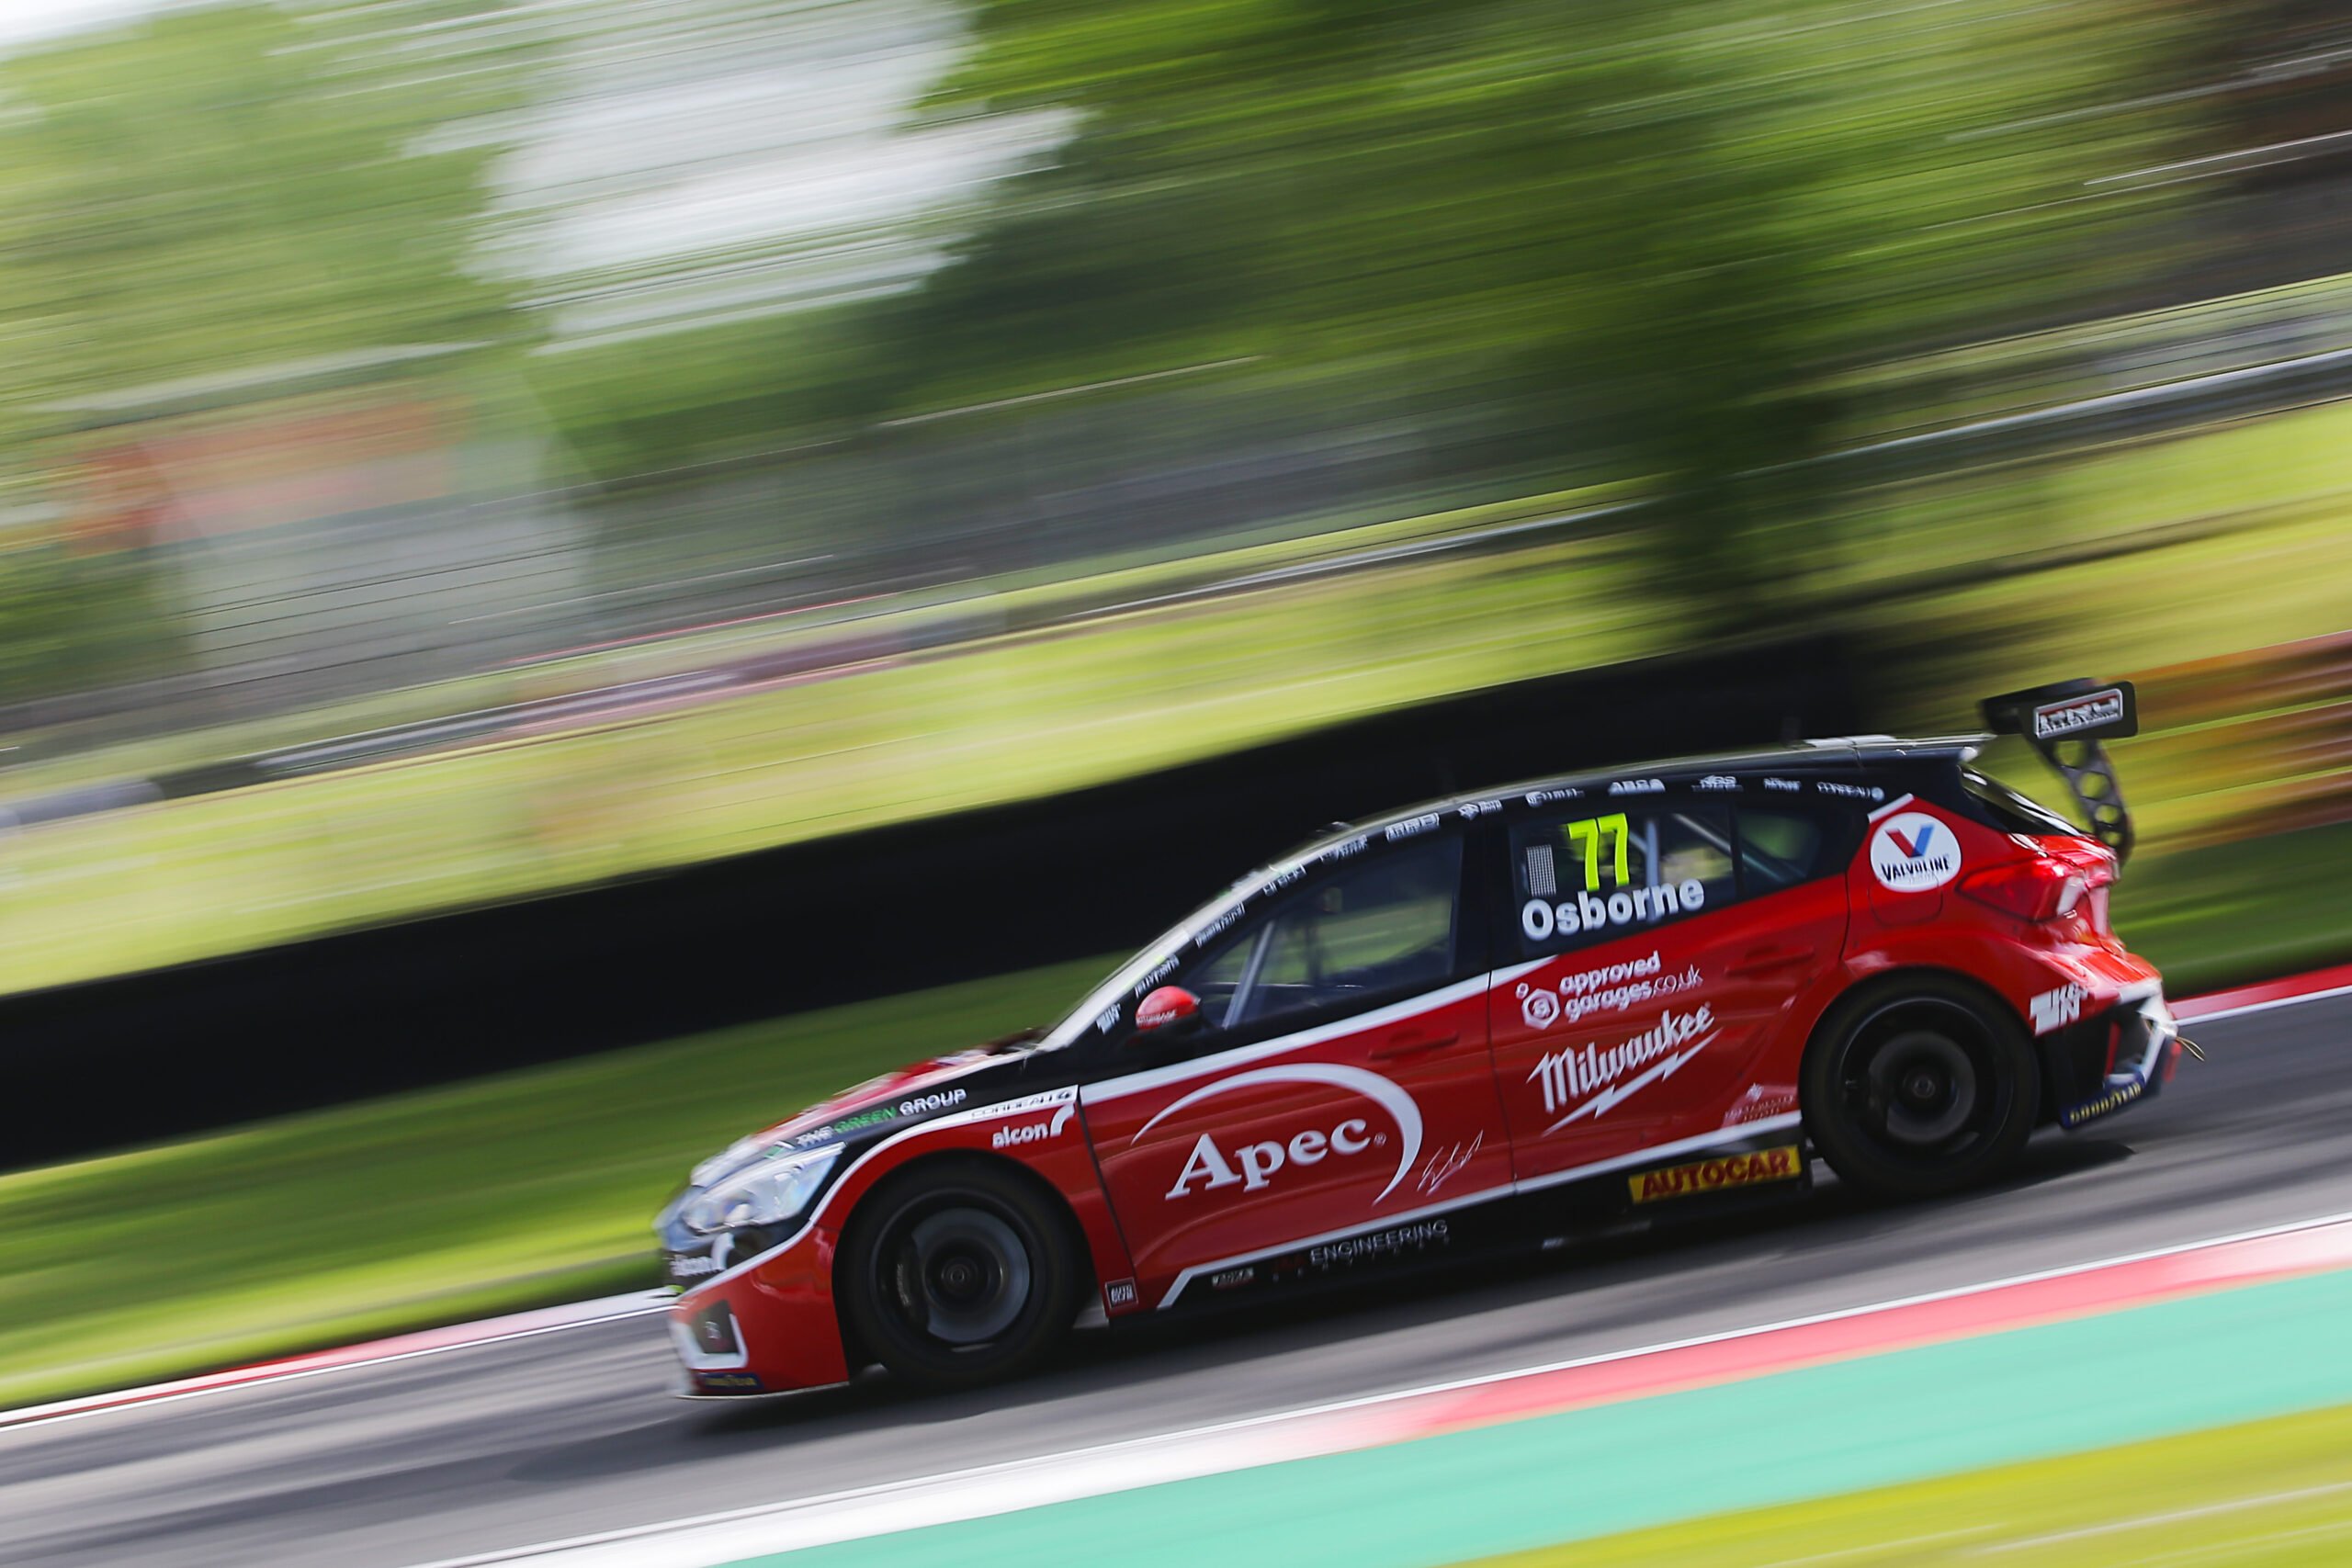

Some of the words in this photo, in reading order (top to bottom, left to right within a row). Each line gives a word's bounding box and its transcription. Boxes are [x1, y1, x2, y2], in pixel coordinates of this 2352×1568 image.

[1567, 813, 1629, 891] 77
[1521, 878, 1705, 941] Osborne
[1559, 950, 1661, 996] approved
[1564, 964, 1703, 1024] garages.co.uk
[1526, 1005, 1714, 1114] Milwaukee
[834, 1106, 898, 1134] GREEN
[899, 1088, 967, 1117] GROUP
[2069, 1082, 2143, 1124] GOODYEAR
[991, 1123, 1048, 1150] alcon
[1165, 1119, 1371, 1201] Apec
[1642, 1149, 1791, 1199] AUTOCAR
[1310, 1219, 1449, 1265] ENGINEERING
